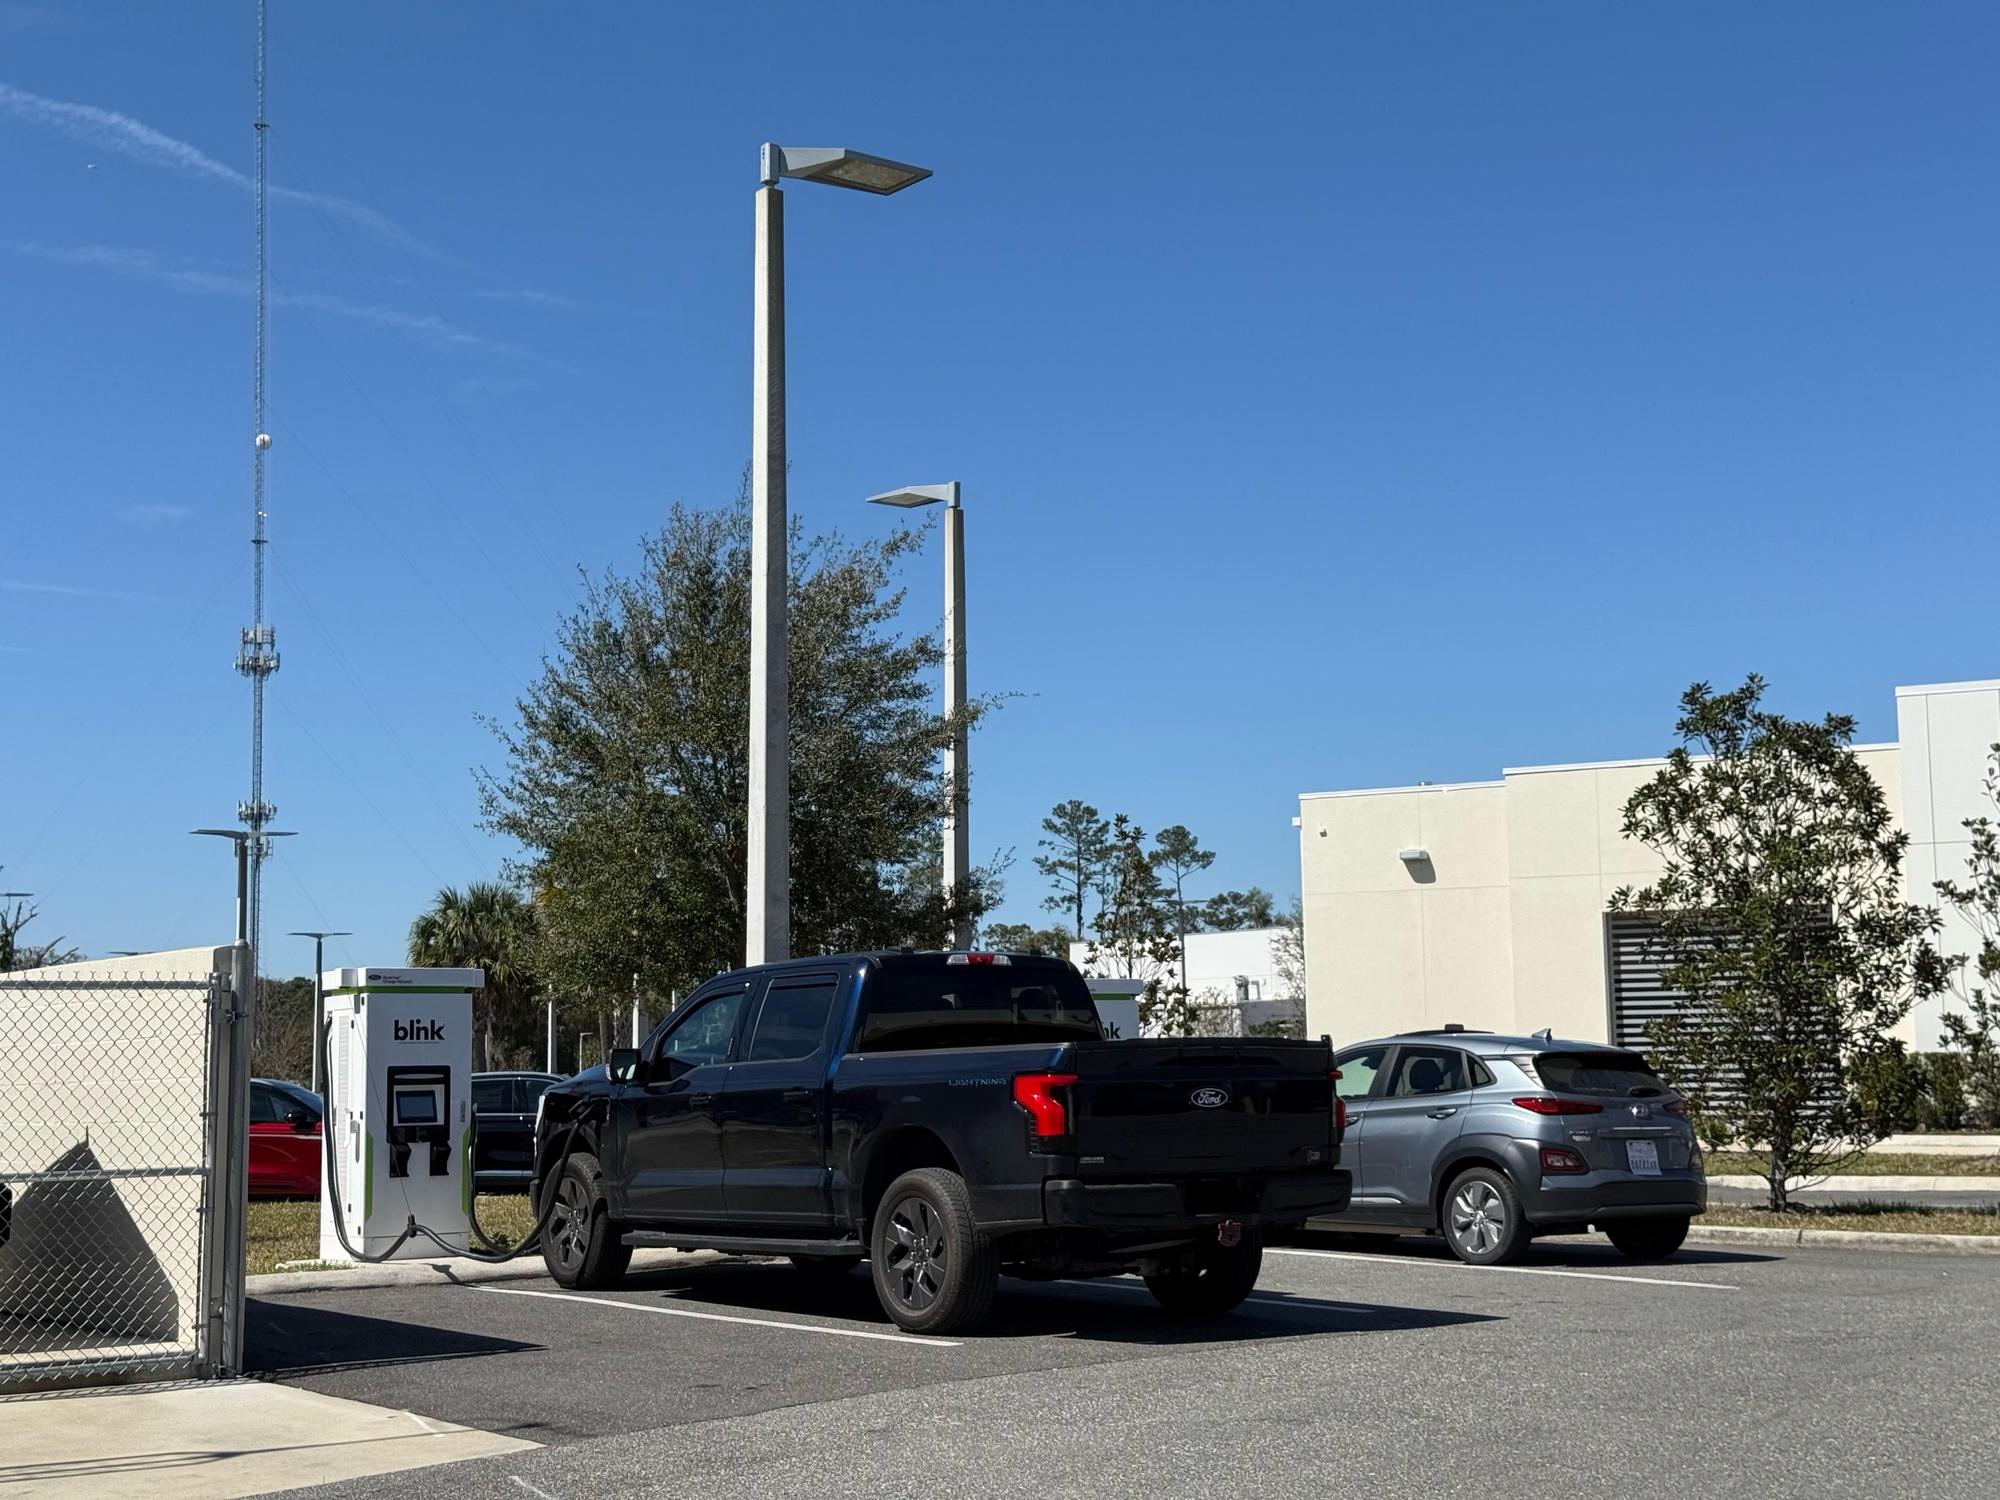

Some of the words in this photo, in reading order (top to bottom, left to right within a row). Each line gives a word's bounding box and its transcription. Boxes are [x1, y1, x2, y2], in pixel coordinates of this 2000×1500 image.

[394, 1019, 445, 1041] blink
[948, 1078, 1007, 1087] LIGHTNING
[1197, 1090, 1222, 1104] Ford
